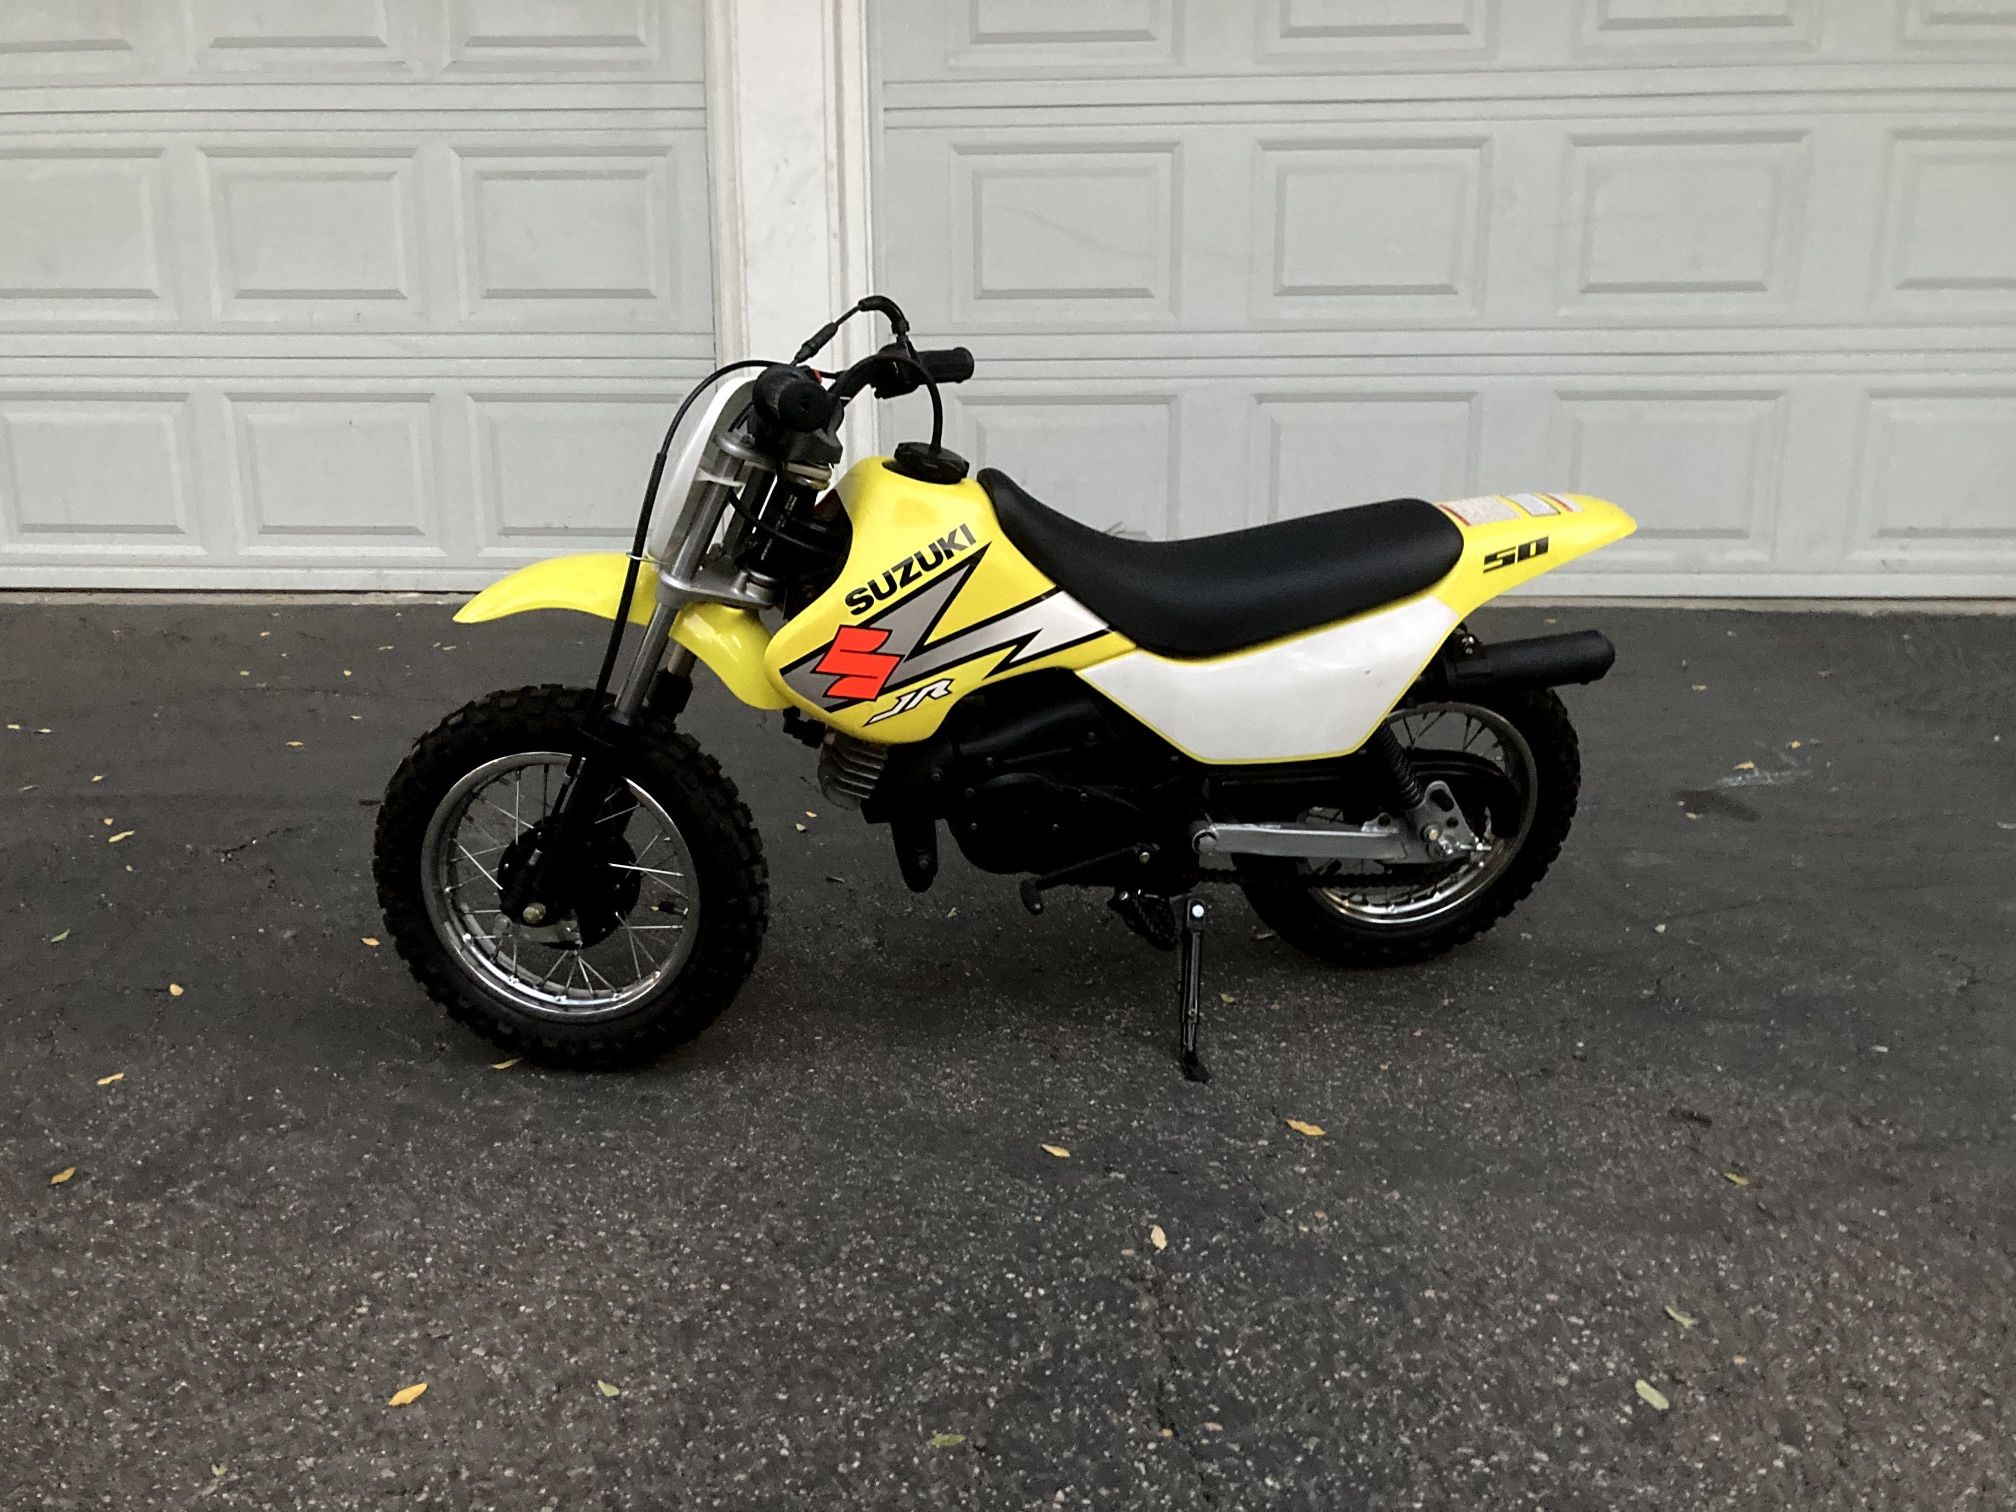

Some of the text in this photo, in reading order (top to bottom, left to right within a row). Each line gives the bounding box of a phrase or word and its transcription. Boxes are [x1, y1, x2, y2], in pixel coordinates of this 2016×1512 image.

[844, 523, 977, 616] SUZUKI
[1483, 536, 1549, 574] 50
[862, 678, 955, 727] JR
